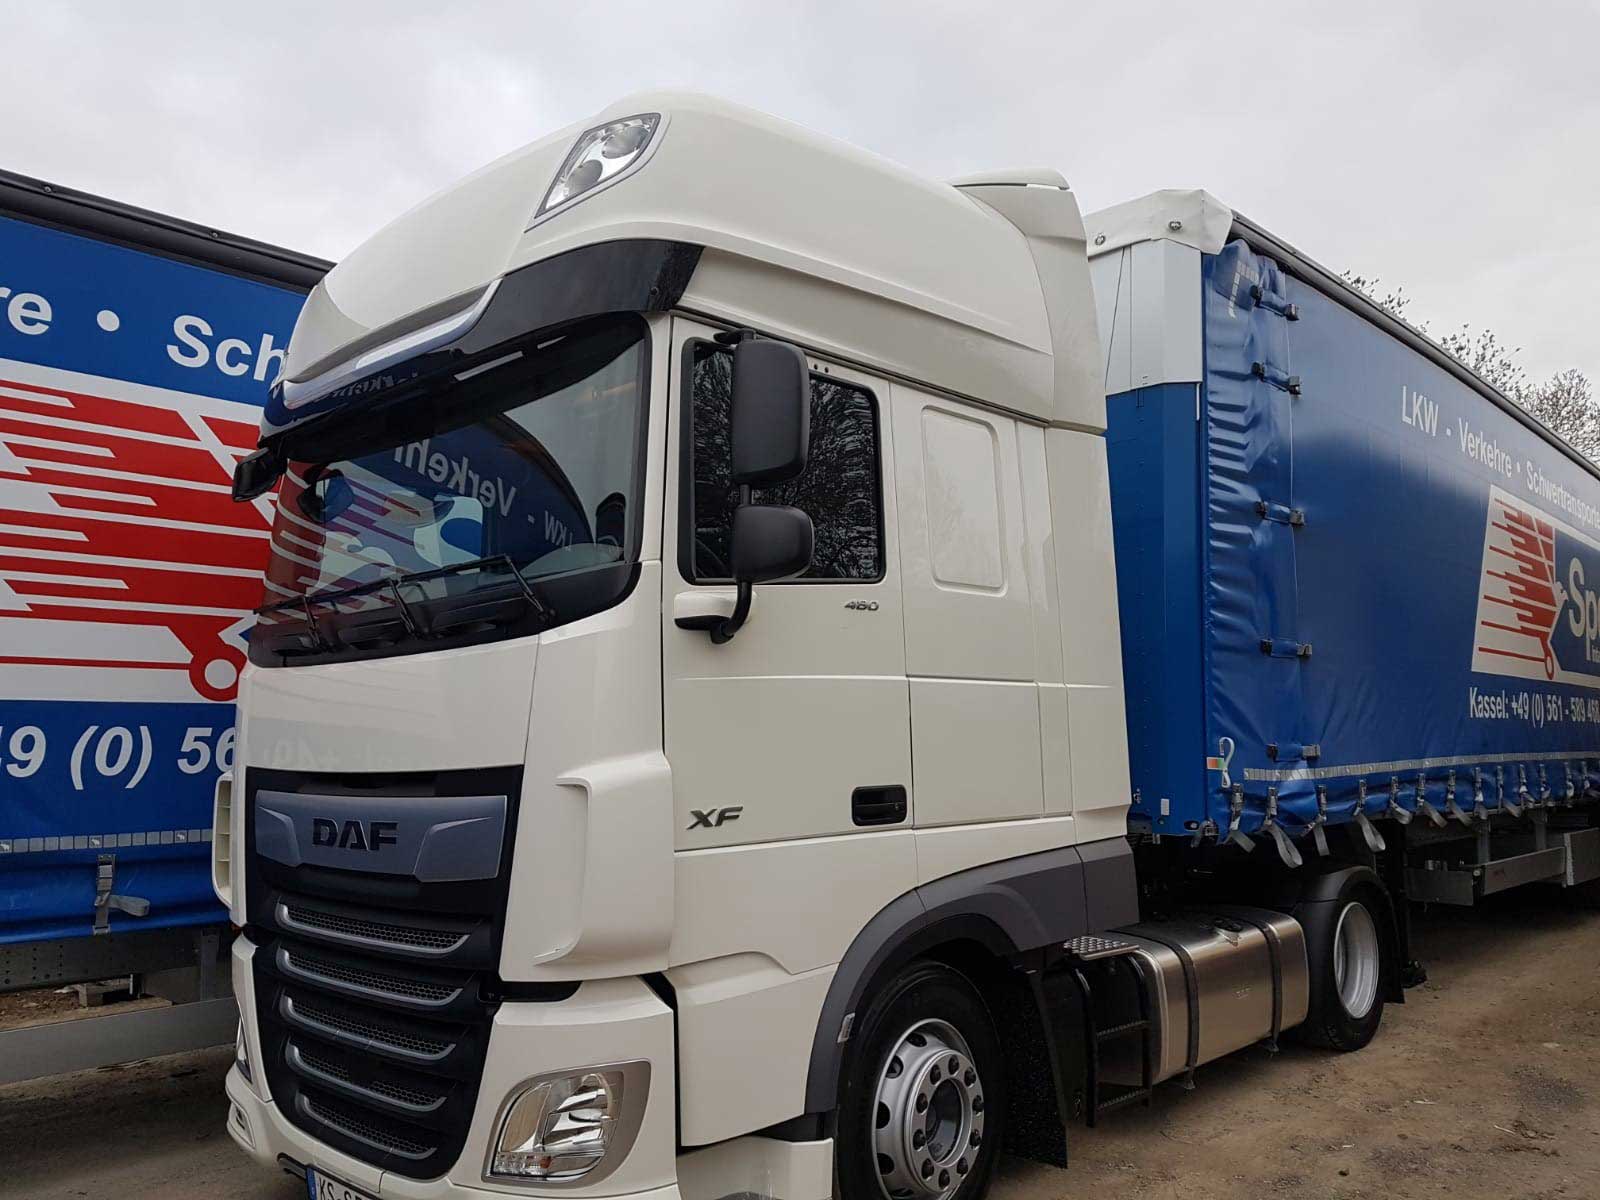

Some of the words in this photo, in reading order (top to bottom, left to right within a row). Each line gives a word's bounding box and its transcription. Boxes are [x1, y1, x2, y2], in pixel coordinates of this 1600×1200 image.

[1402, 385, 1439, 437] LKW
[1458, 417, 1512, 478] Verkehre
[1568, 556, 1600, 661] Sp
[1469, 686, 1509, 719] Kassel:
[1511, 691, 1529, 720] +49
[1532, 692, 1544, 728] (0)
[1546, 694, 1562, 721] 561
[0, 725, 46, 778] 9
[70, 725, 152, 790] (0)
[312, 817, 399, 851] DAF
[686, 806, 744, 830] XF
